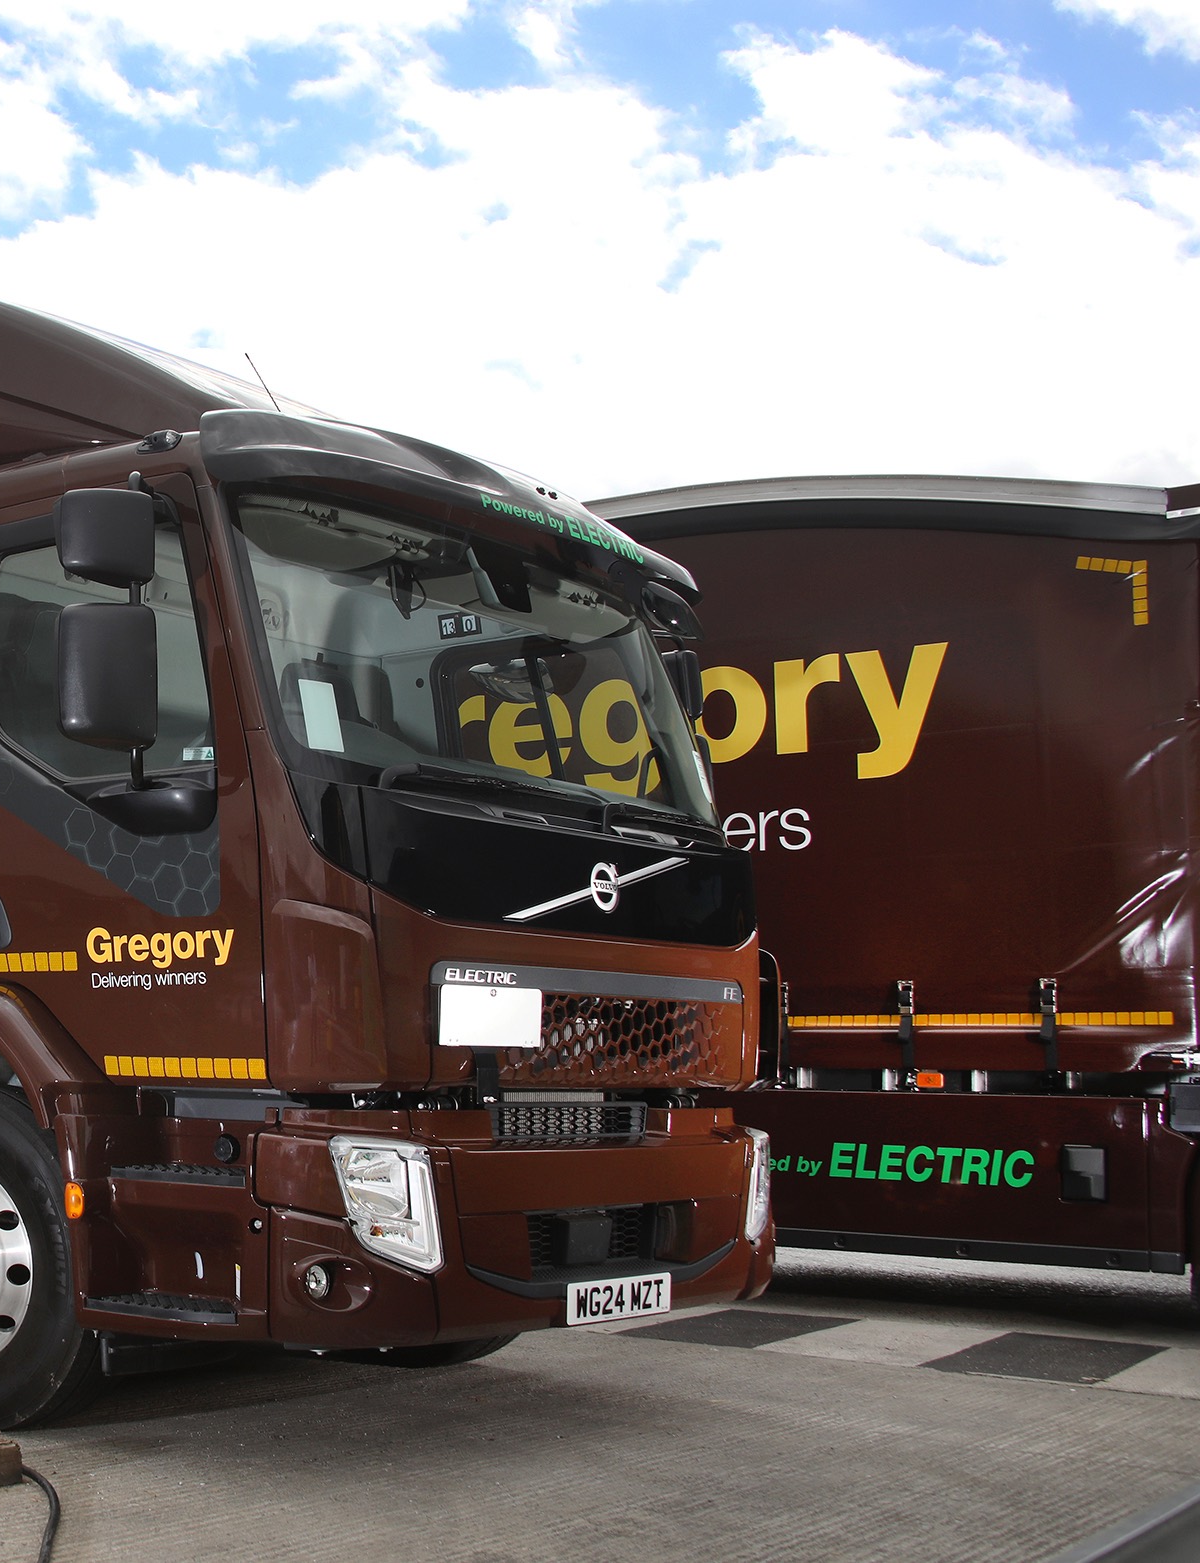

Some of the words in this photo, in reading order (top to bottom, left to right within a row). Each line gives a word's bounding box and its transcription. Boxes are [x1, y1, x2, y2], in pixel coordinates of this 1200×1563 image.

[480, 493, 545, 525] Powered
[547, 513, 564, 534] by
[565, 515, 644, 564] ELECTRIC
[593, 881, 617, 892] VOLVO
[86, 927, 234, 968] Gregory
[91, 971, 151, 990] Delivering
[155, 970, 207, 986] winners
[445, 968, 517, 985] ELECTRIC
[724, 987, 738, 1000] FE
[796, 1156, 822, 1177] by
[829, 1142, 1035, 1188] ELECTRIC
[576, 1284, 625, 1319] WG24
[631, 1279, 663, 1311] MZT
